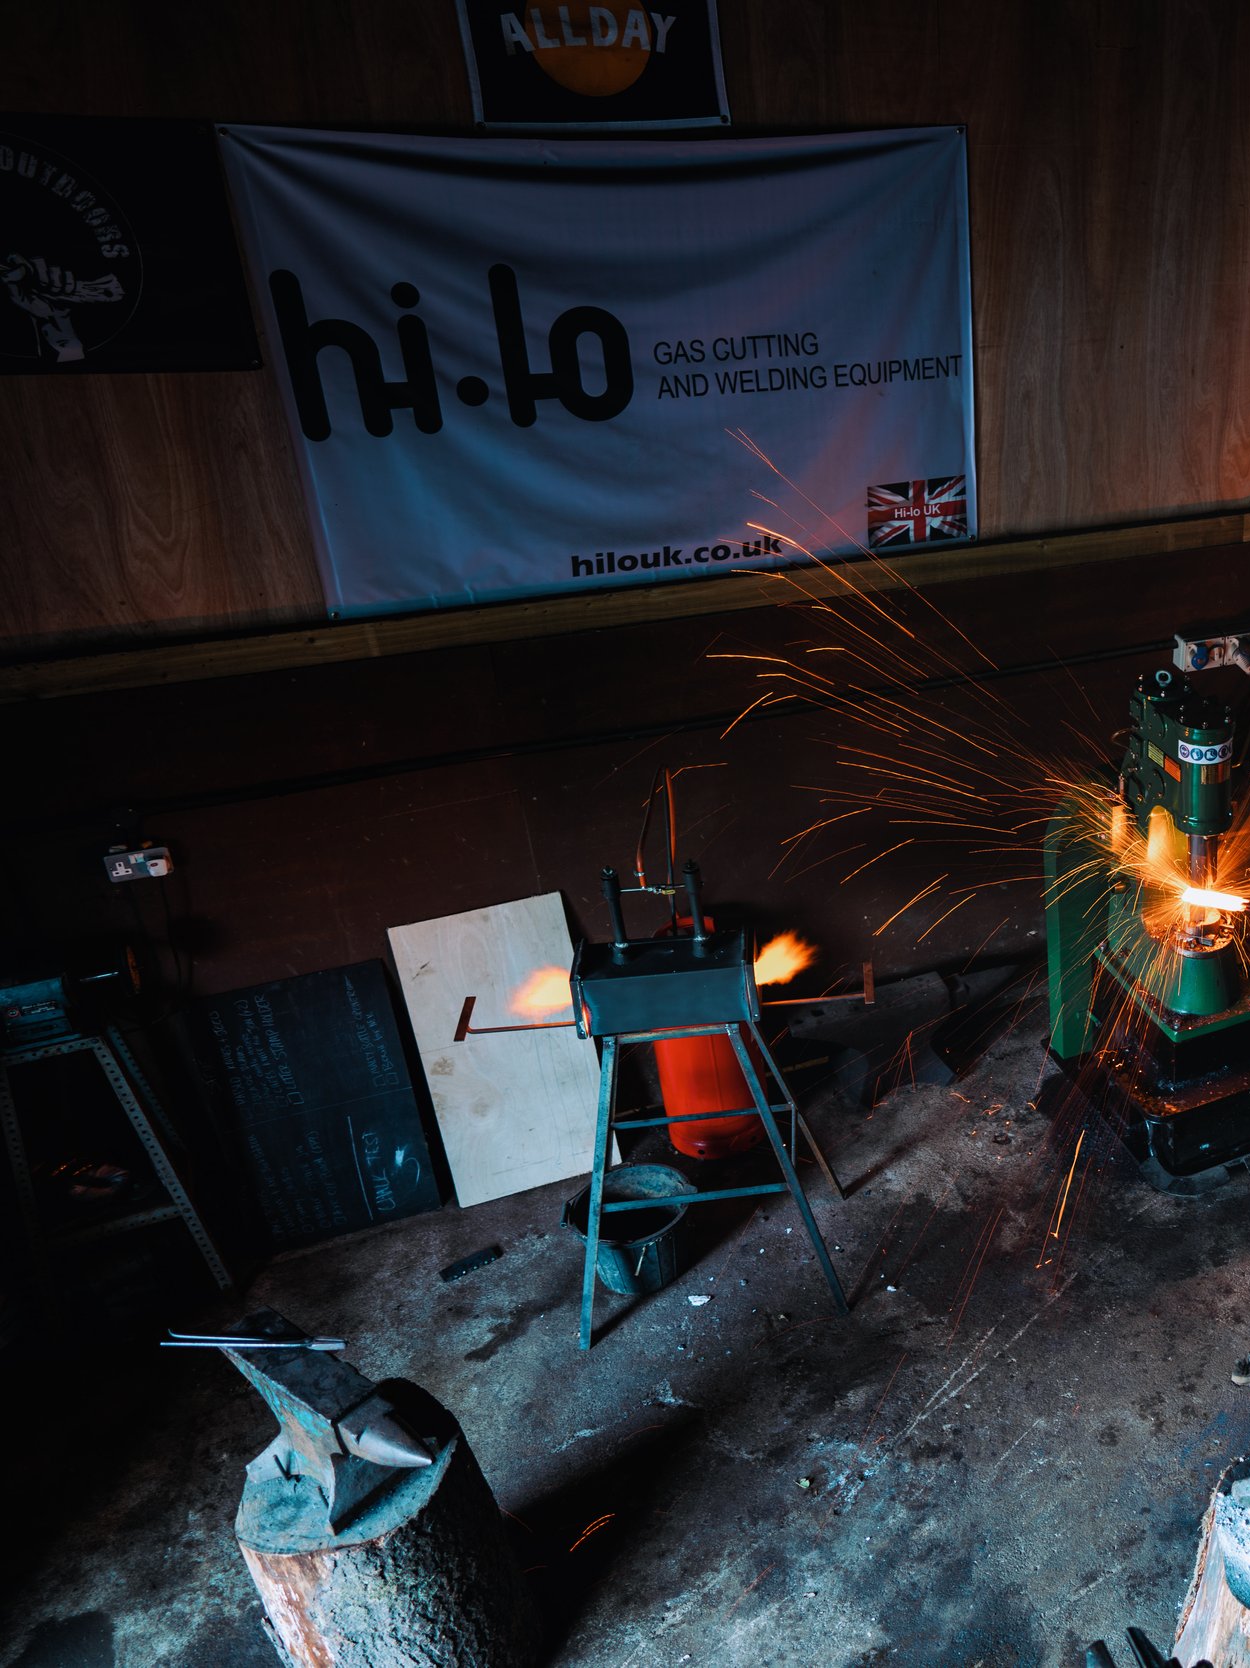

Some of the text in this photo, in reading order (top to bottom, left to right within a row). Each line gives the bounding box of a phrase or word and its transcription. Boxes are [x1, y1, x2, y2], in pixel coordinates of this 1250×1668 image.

[499, 5, 677, 57] ALLDAY
[653, 332, 819, 365] GAS CUTTING
[657, 354, 963, 400] AND WELDING EQUIPMENT
[894, 504, 941, 518] Hi-lo UK
[571, 533, 784, 578] hilouk.co.uk
[253, 992, 274, 1027] HOLDER
[264, 1026, 287, 1060] STAMP
[359, 1129, 384, 1167] TEST
